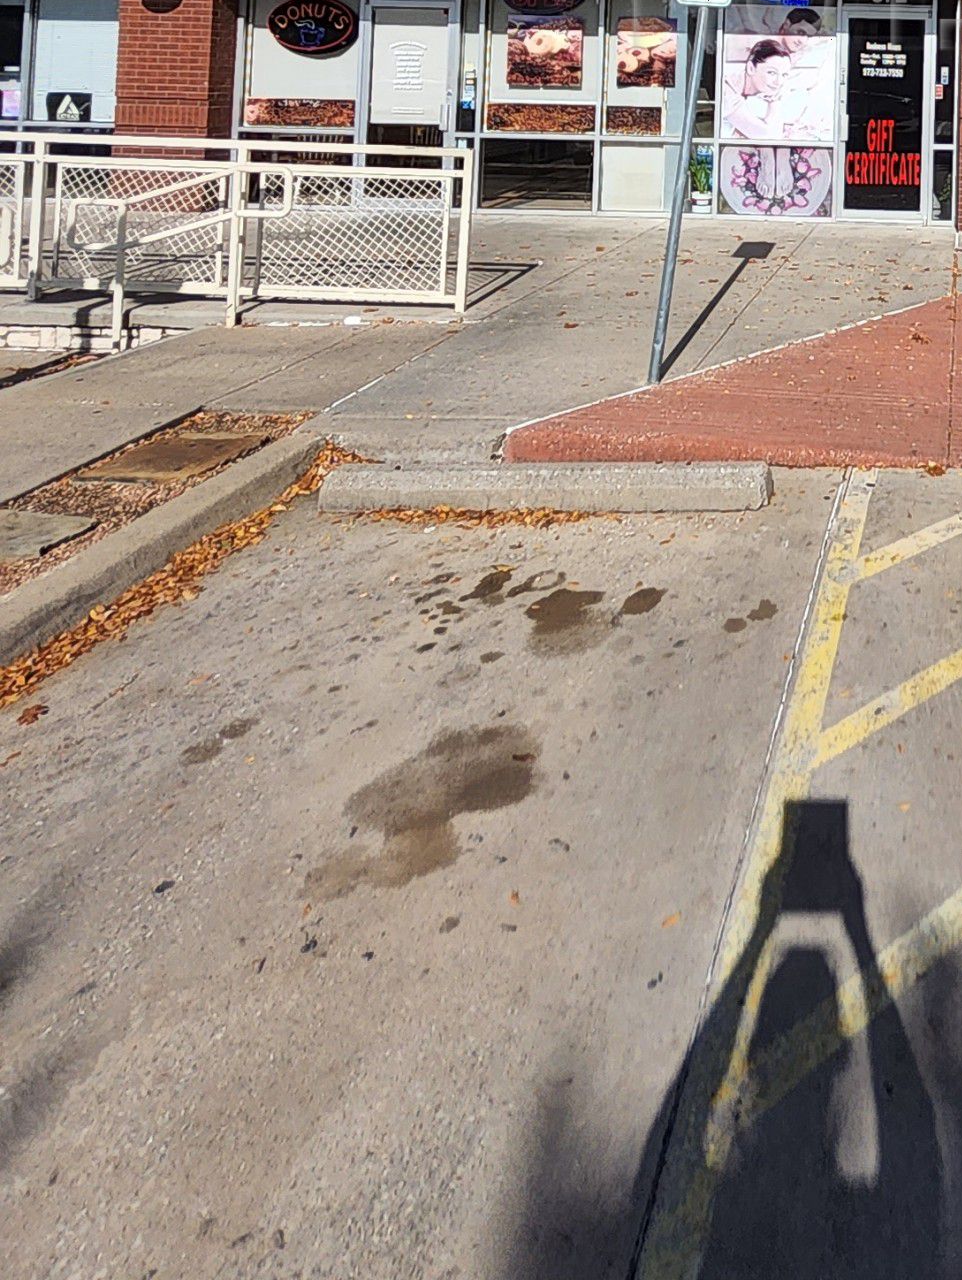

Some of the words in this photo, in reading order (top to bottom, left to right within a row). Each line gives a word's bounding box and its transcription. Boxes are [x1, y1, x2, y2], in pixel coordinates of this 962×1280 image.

[275, 3, 349, 30] DONUTS
[866, 119, 895, 152] GIFT
[845, 152, 921, 186] CERTIFICATE
